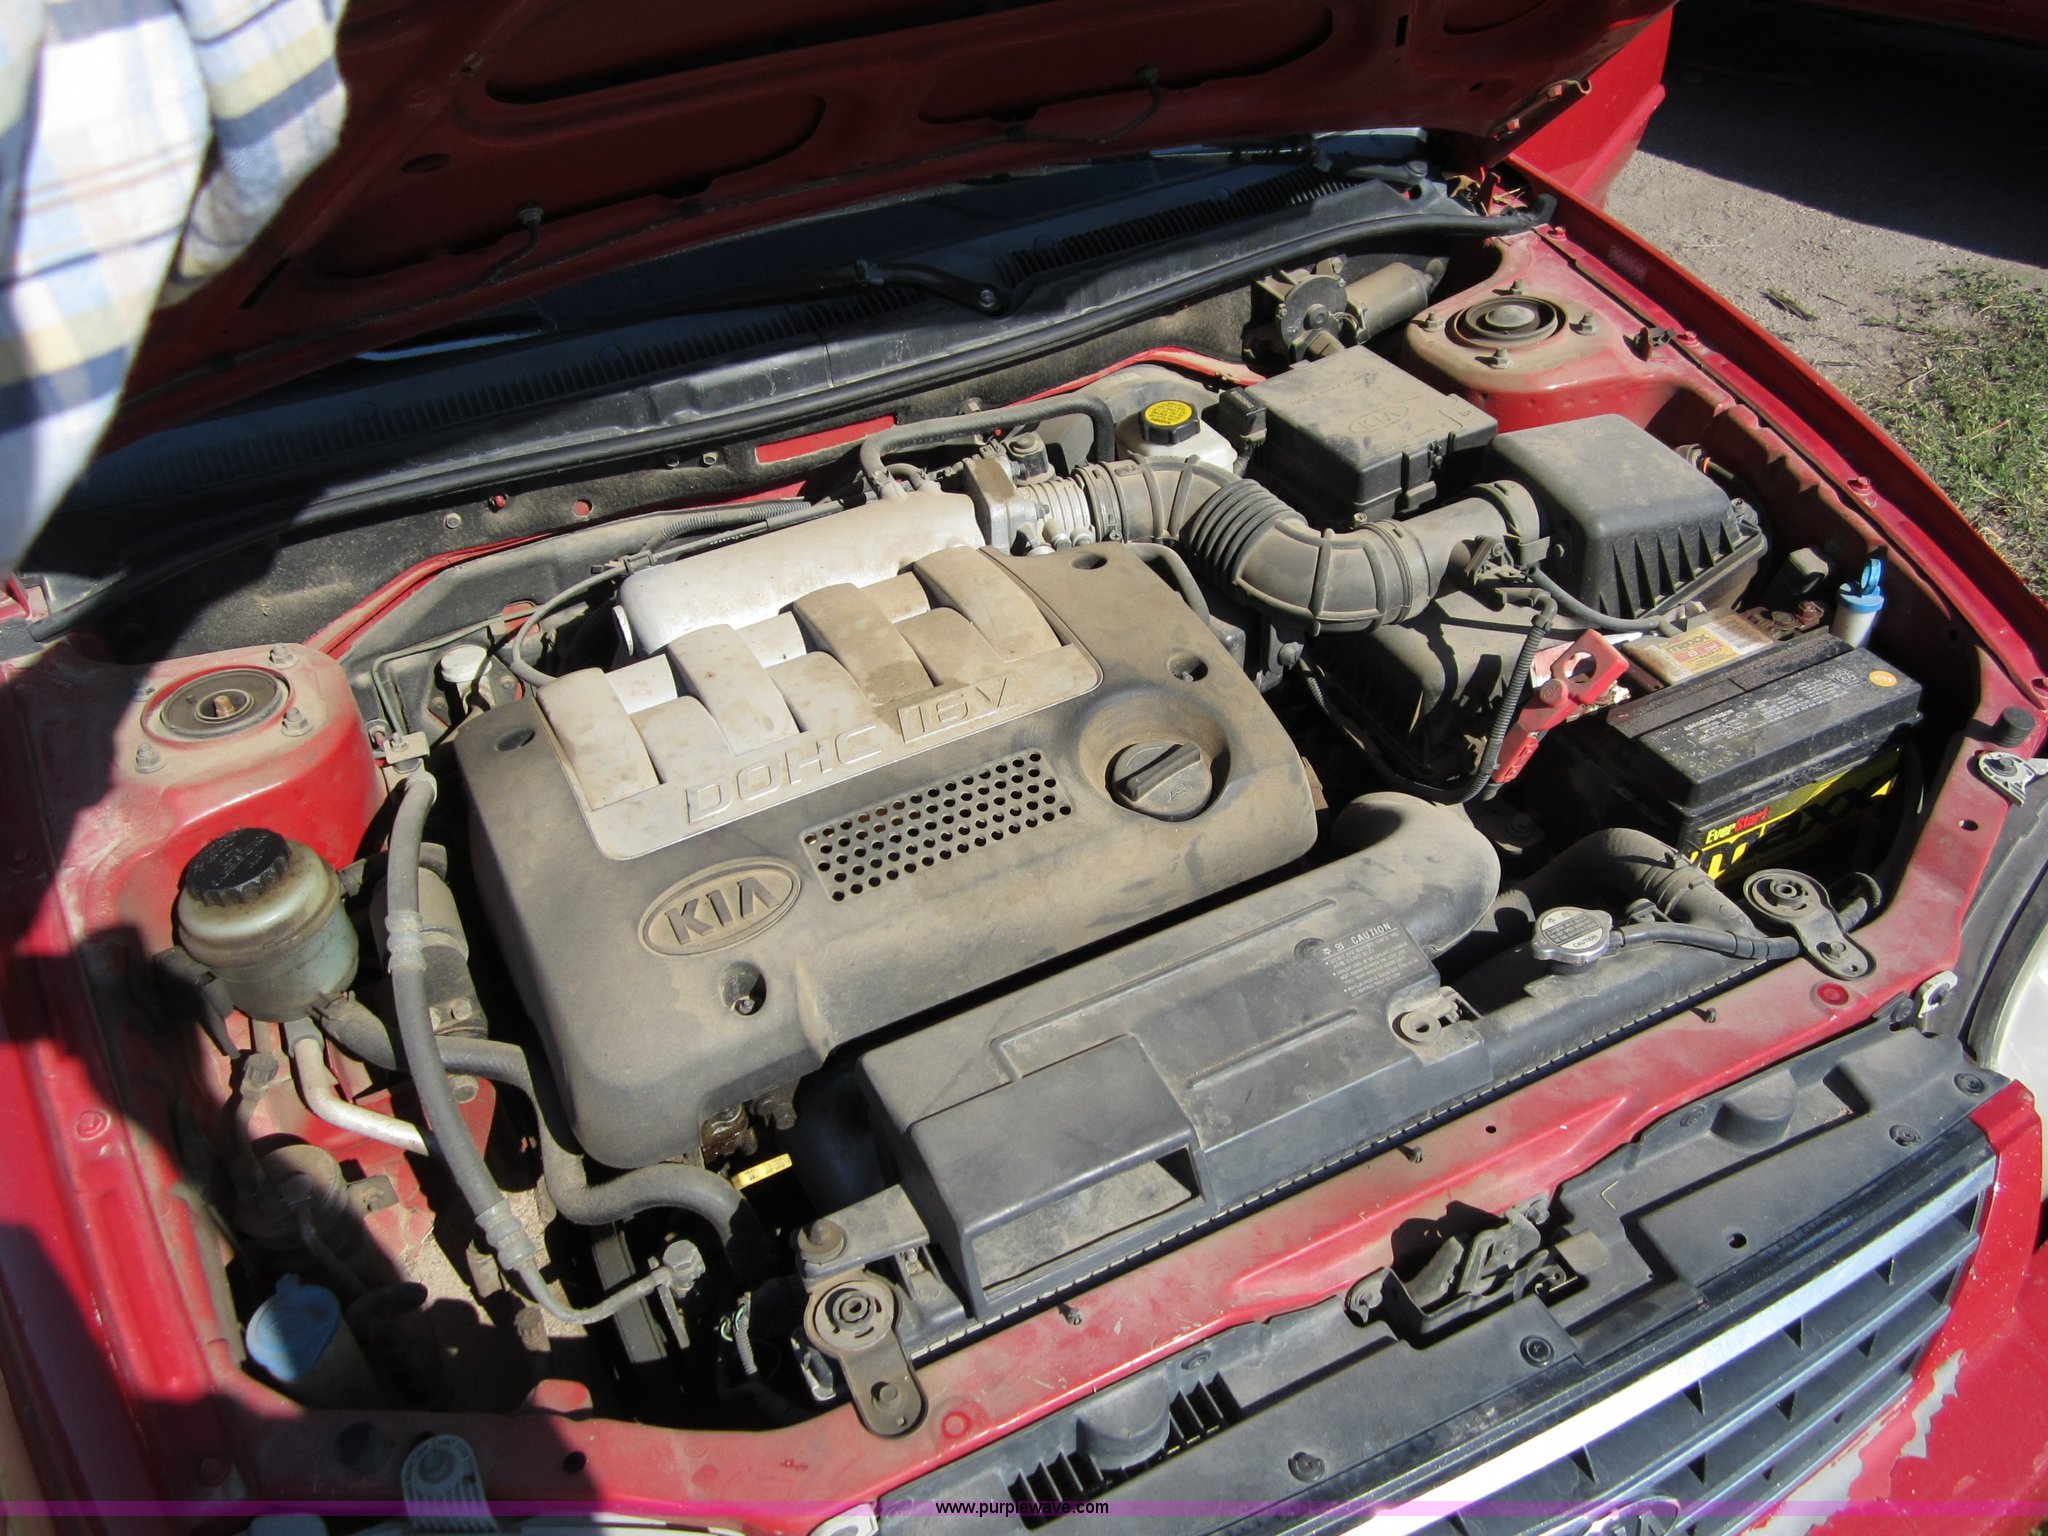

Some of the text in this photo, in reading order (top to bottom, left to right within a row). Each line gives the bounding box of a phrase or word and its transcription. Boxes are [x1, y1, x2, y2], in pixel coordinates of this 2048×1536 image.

[686, 677, 1008, 824] DOHC 16V
[1705, 806, 1771, 844] EverStart
[664, 876, 779, 945] KIA
[1350, 921, 1392, 945] CAUTION
